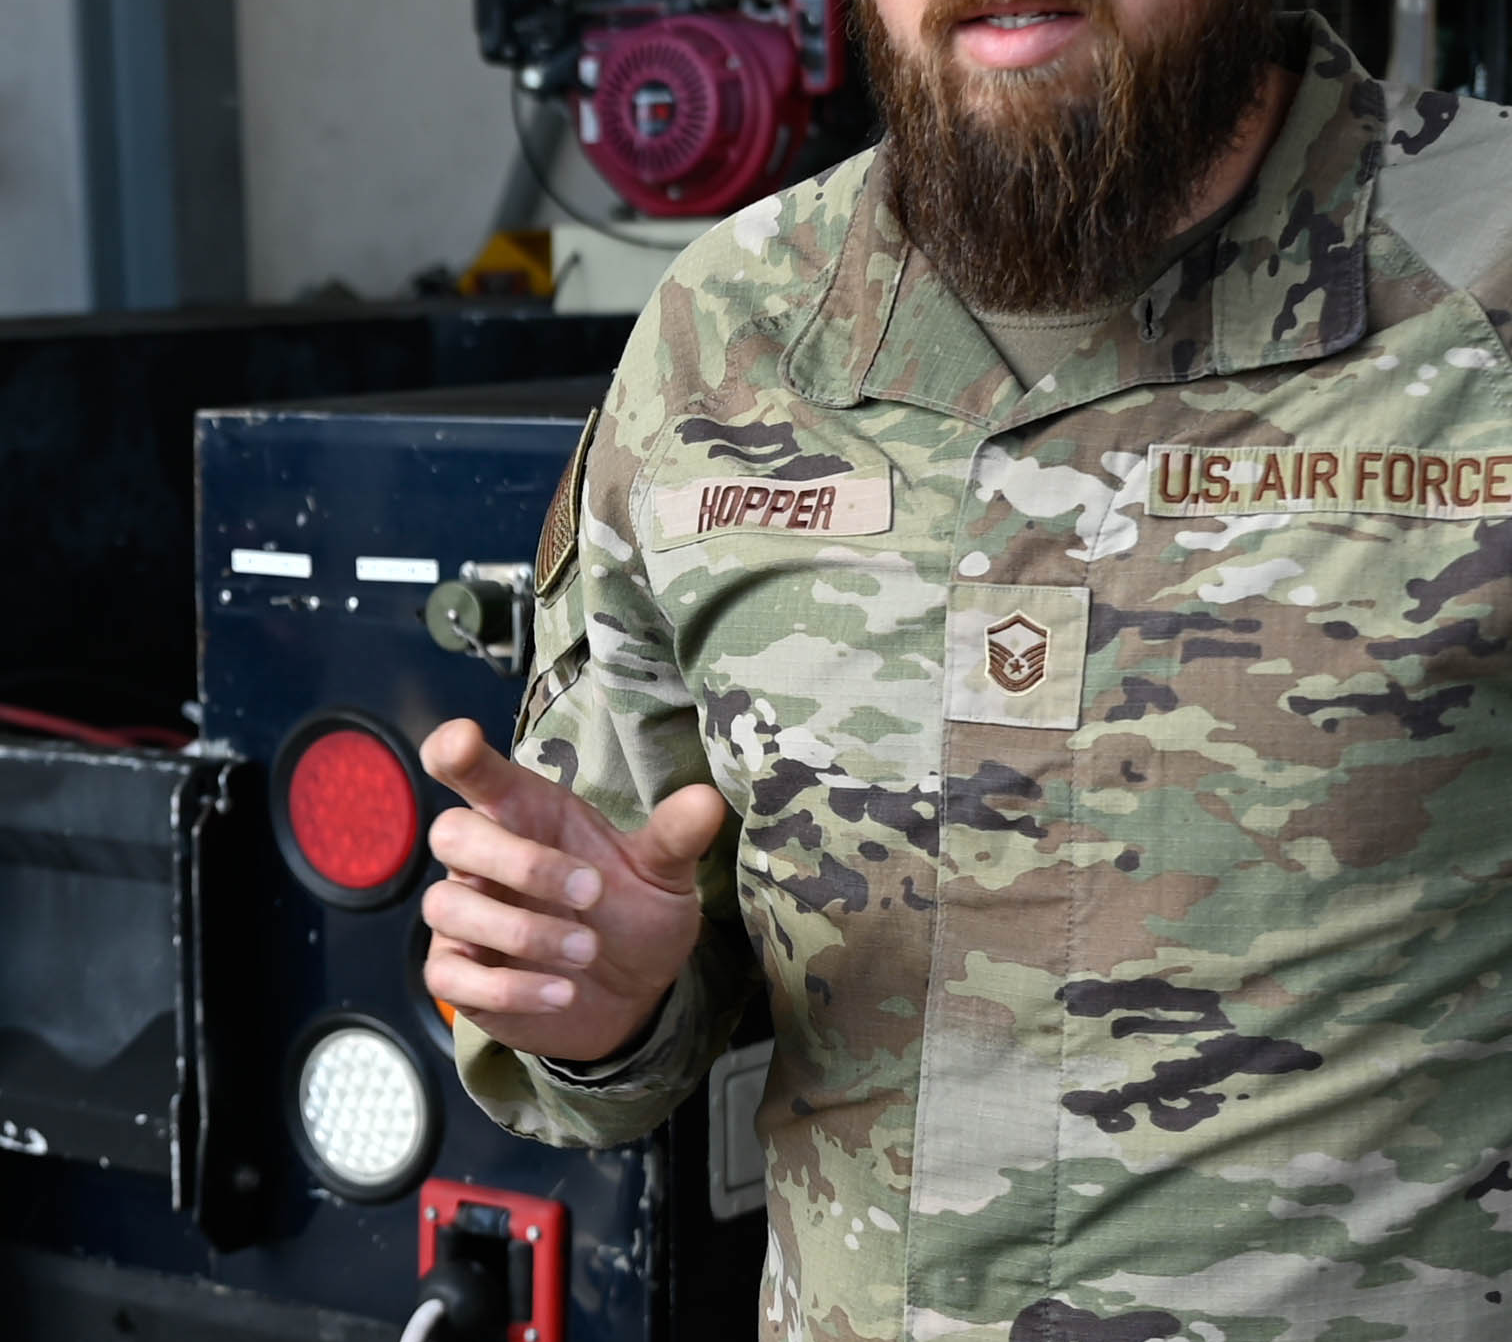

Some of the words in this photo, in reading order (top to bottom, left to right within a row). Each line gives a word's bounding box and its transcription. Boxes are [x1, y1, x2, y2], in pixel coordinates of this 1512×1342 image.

[1160, 452, 1239, 504] U.S.
[1252, 452, 1339, 502] AIR
[697, 484, 837, 534] HOPPER
